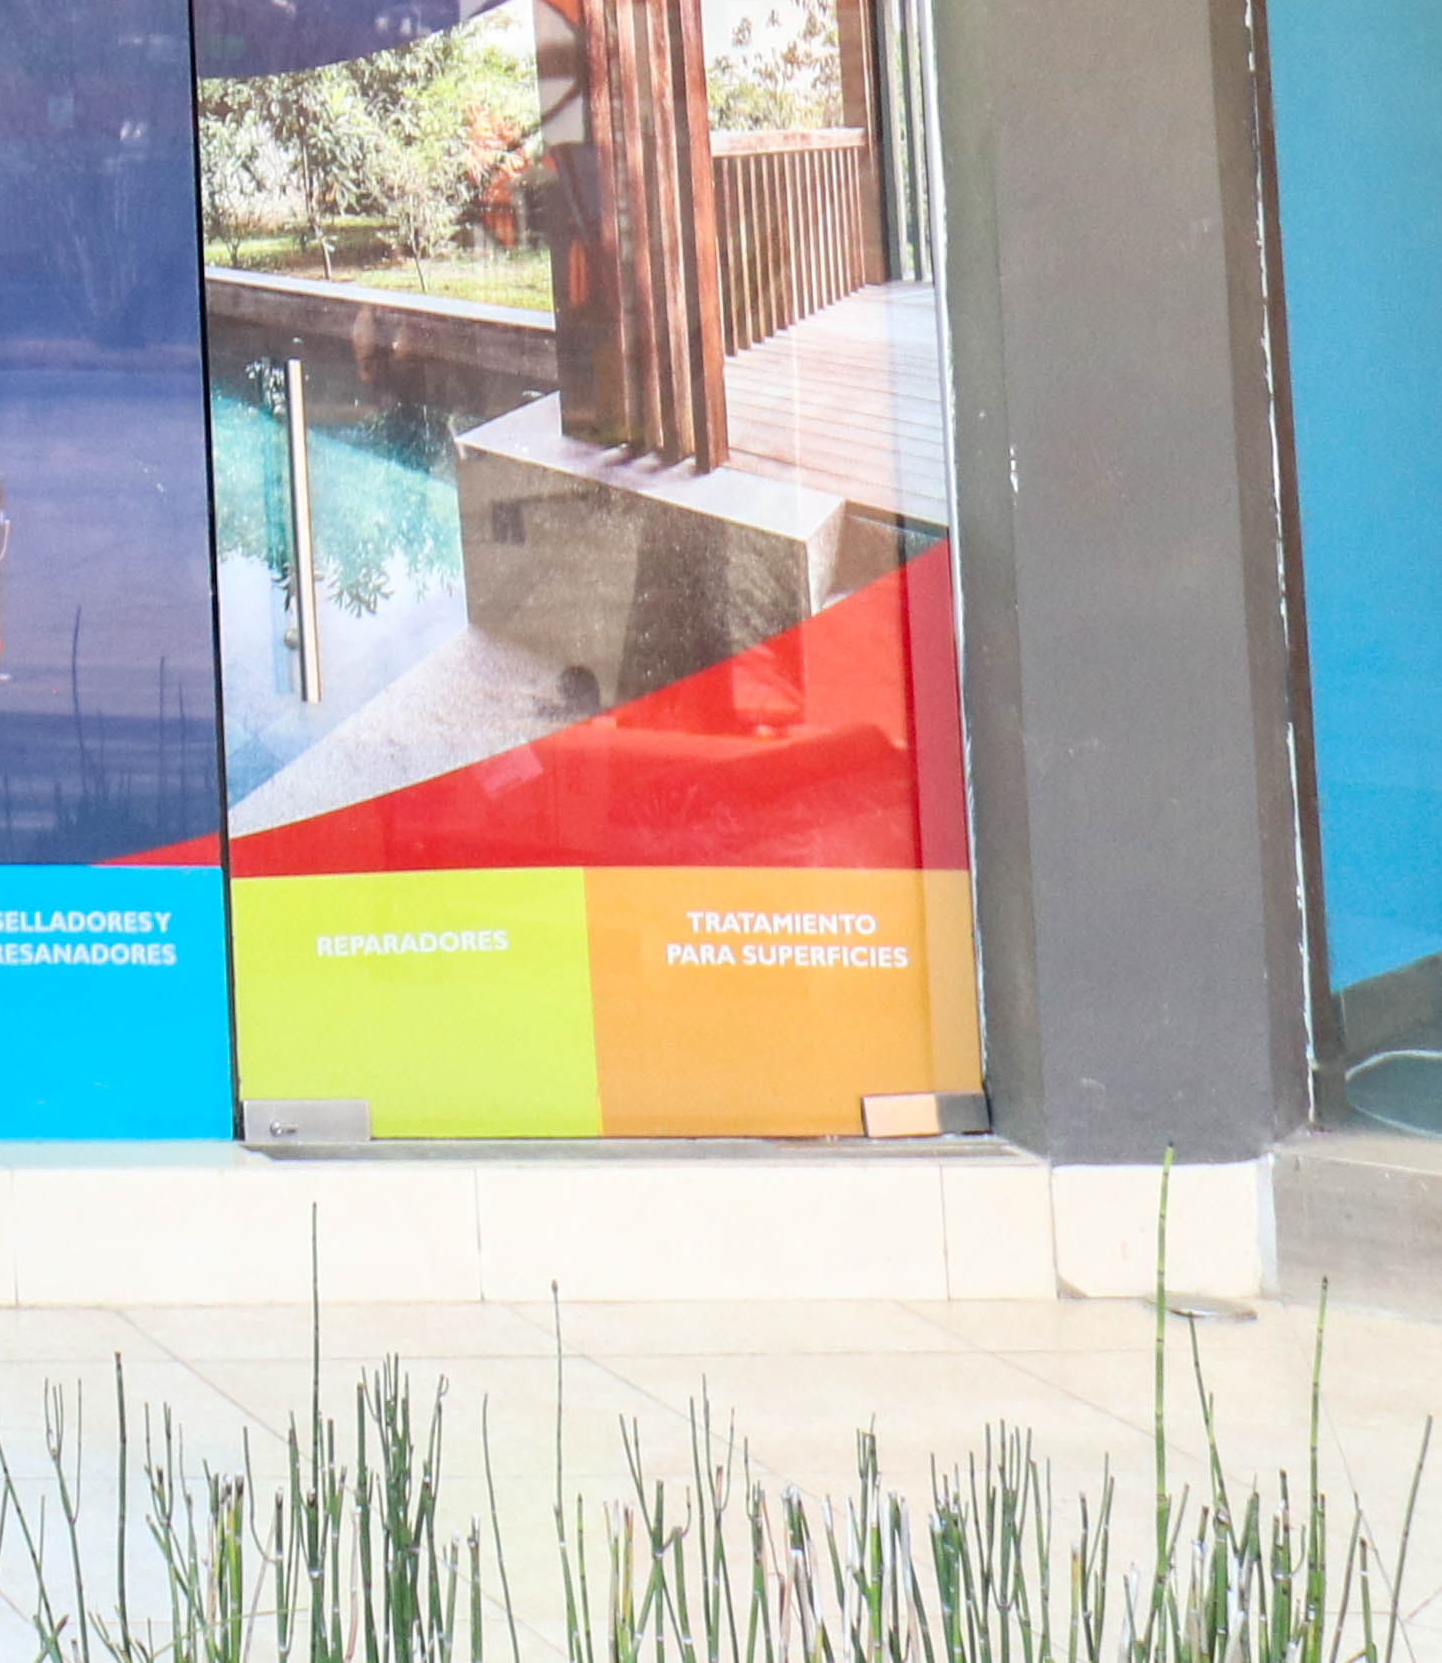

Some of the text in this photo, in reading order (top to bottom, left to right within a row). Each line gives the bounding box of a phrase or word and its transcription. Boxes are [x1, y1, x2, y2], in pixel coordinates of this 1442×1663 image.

[151, 910, 172, 935] Y
[686, 911, 877, 938] TRATAMIENTO
[315, 931, 509, 958] REPARADORES
[666, 942, 909, 972] PARA SUPERFICIES
